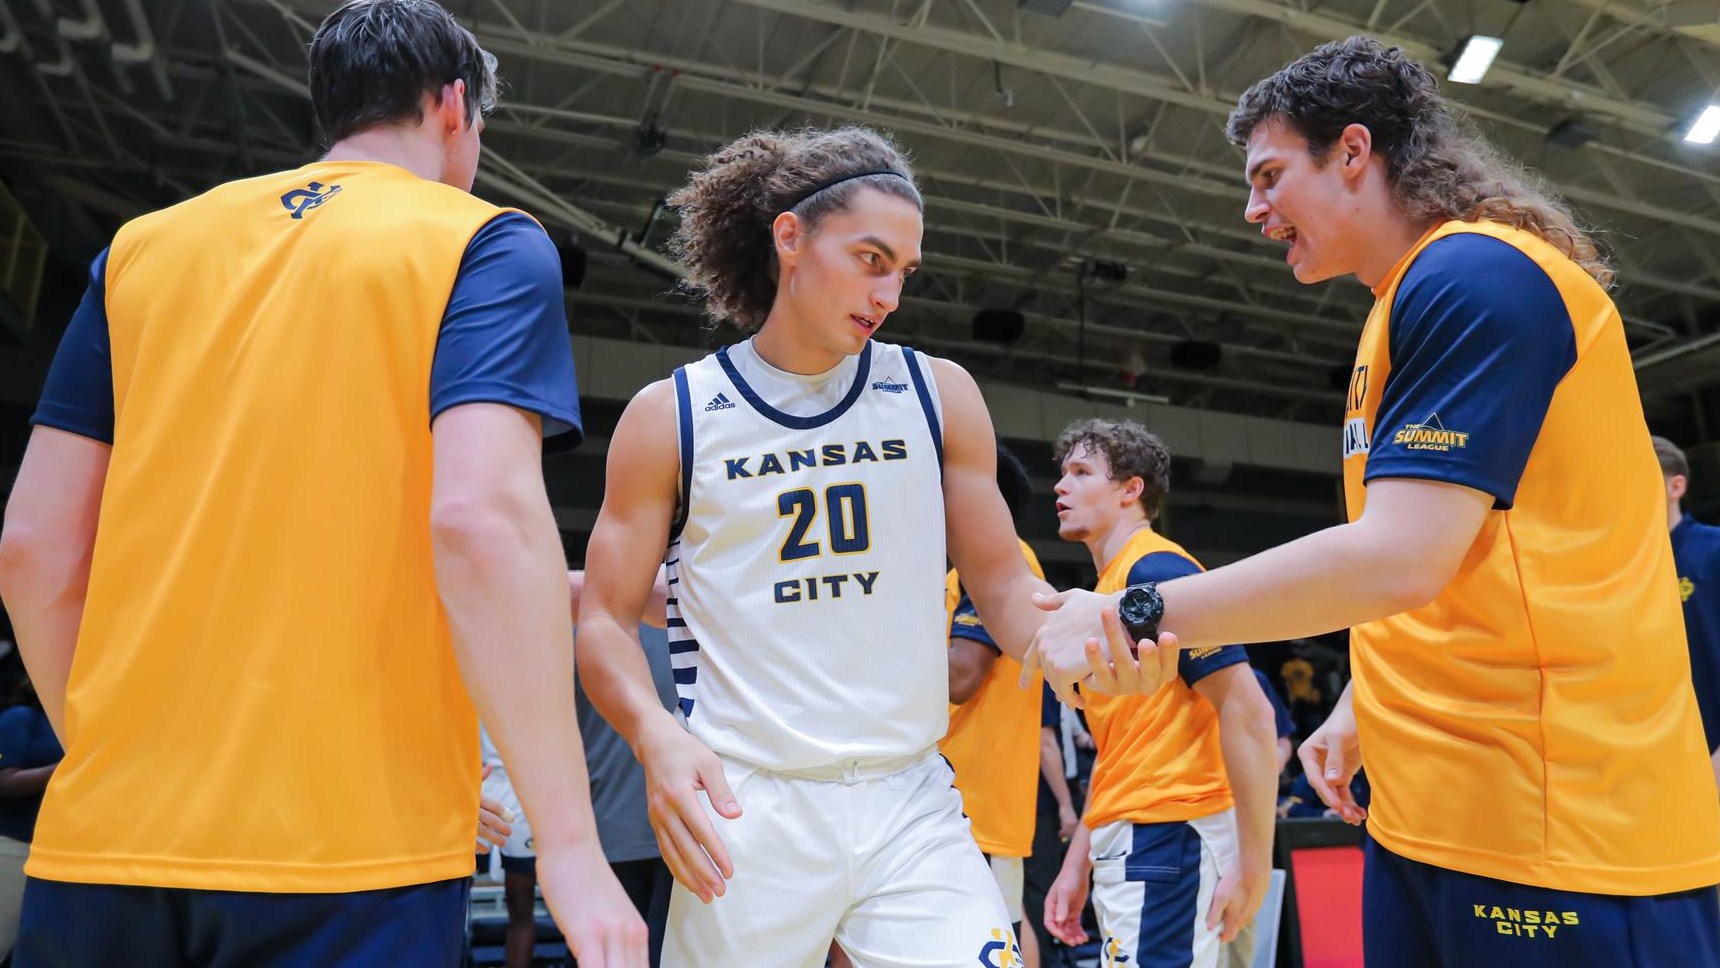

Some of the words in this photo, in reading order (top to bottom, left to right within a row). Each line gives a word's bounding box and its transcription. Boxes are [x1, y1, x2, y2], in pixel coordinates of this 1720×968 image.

[705, 402, 736, 412] adidas
[1394, 429, 1468, 448] SUMMIT
[1407, 443, 1449, 452] LEAGUE
[724, 439, 908, 480] KANSAS
[776, 481, 872, 564] 20
[774, 571, 880, 603] CITY
[1473, 904, 1580, 925] KANSAS
[1496, 920, 1558, 938] CITY
